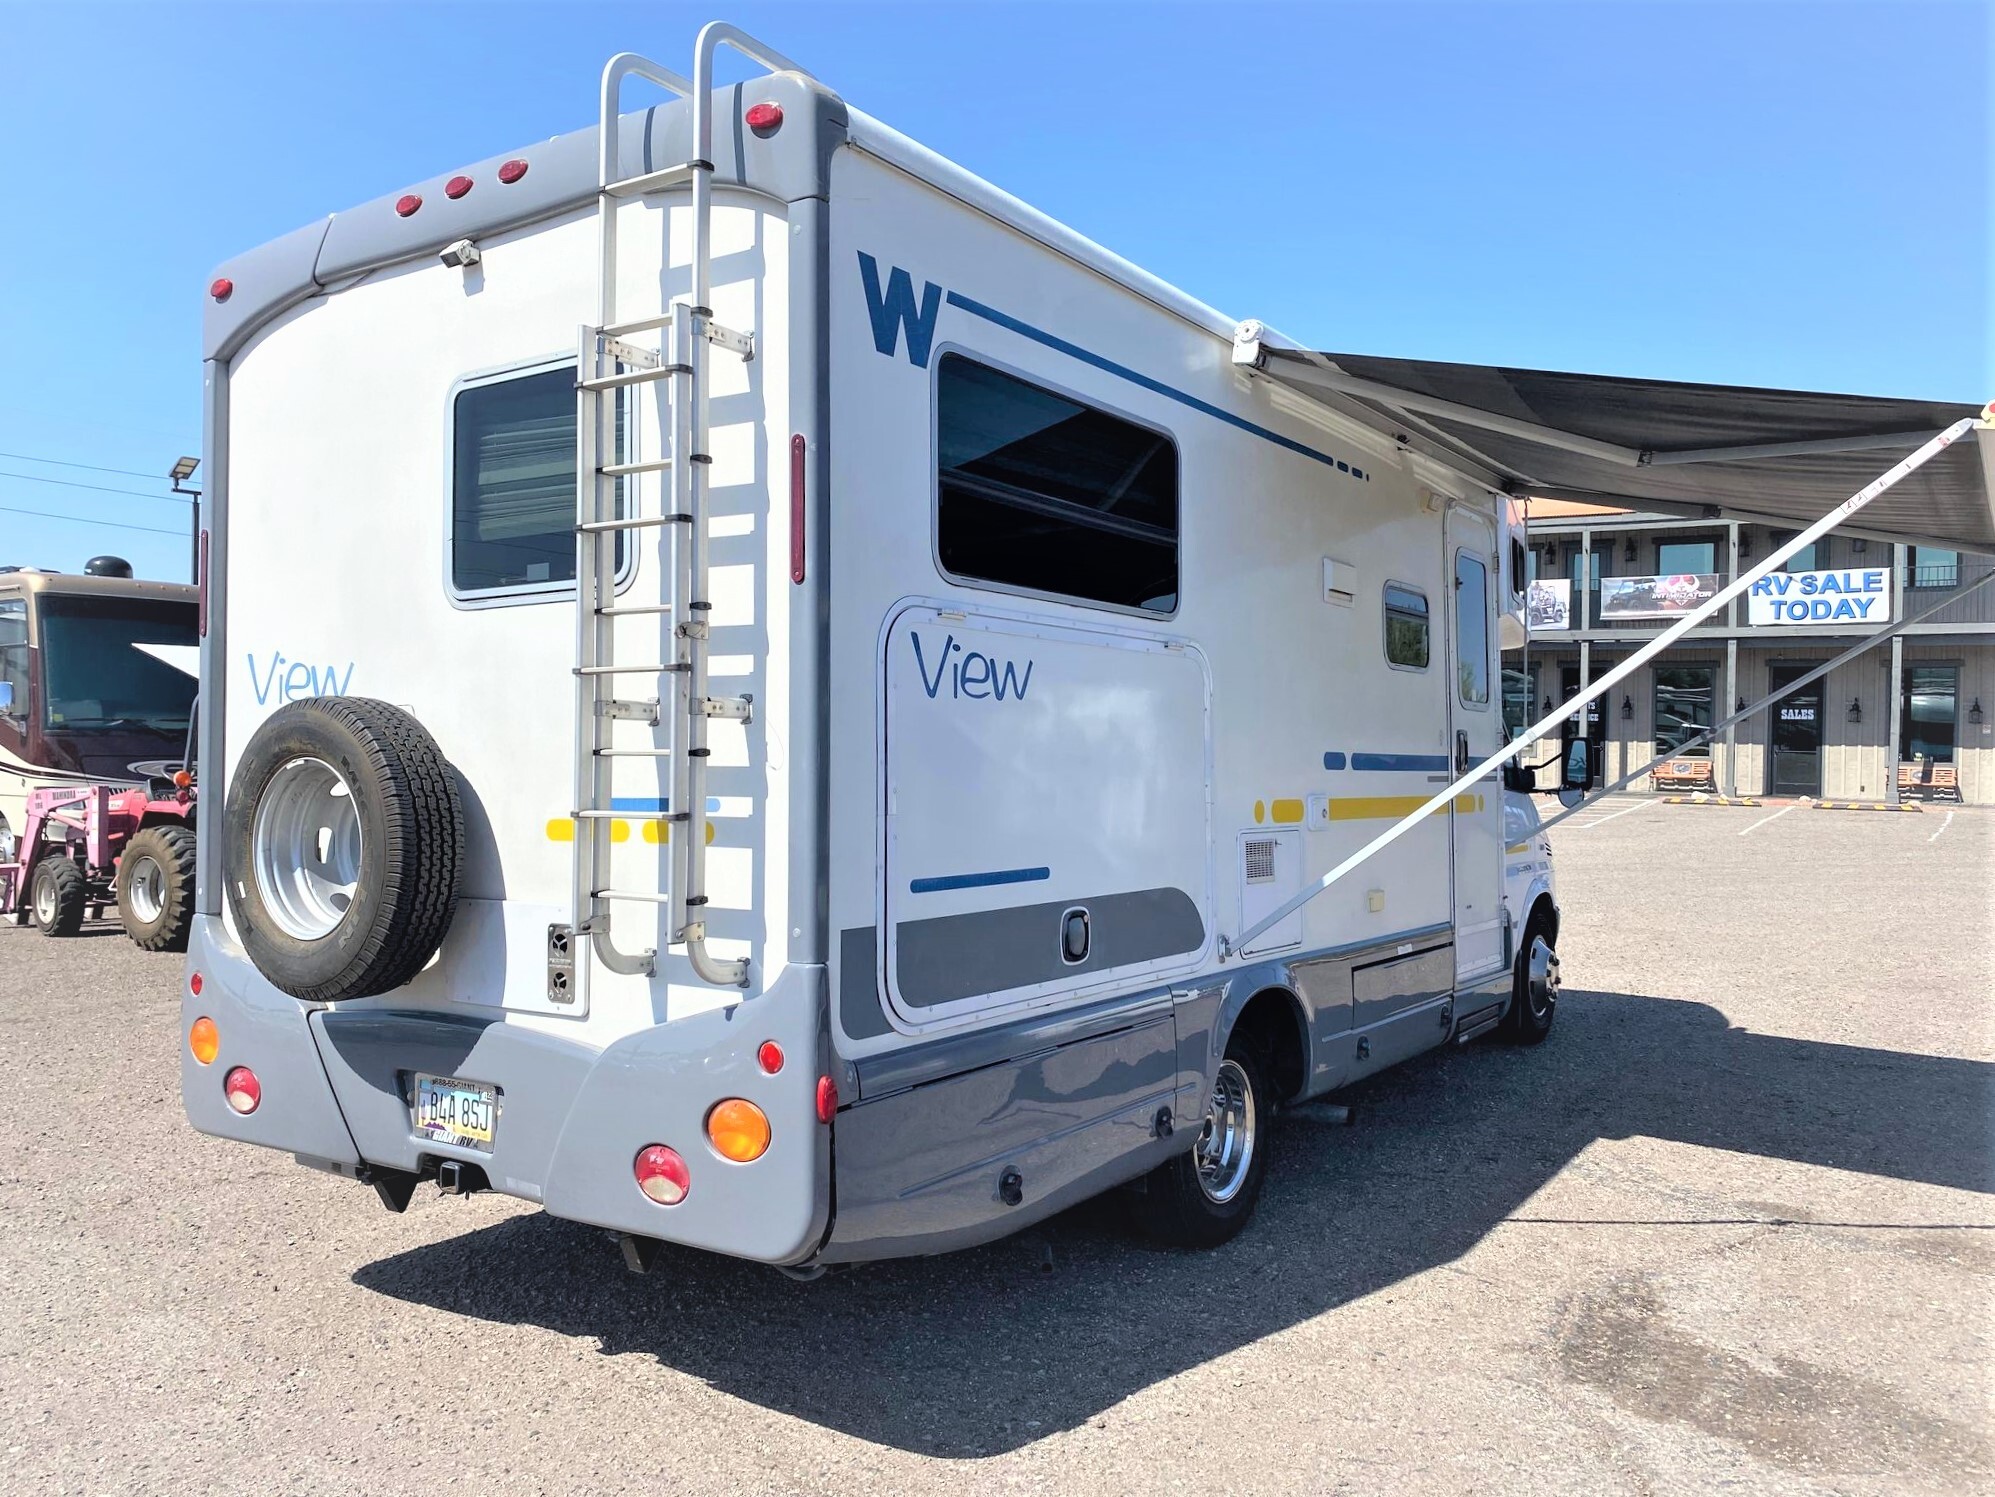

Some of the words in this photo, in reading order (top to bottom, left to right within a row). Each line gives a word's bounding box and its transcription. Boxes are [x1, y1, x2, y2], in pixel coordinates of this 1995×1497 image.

[857, 250, 942, 369] W
[1651, 591, 1712, 600] INTIMIDATOR
[1752, 575, 1793, 596] RV
[1799, 571, 1883, 595] SALE
[1770, 597, 1876, 620] TODAY
[247, 650, 354, 705] View
[911, 631, 1033, 701] View
[1781, 709, 1815, 720] SALES
[430, 1092, 456, 1125] B4A
[461, 1097, 489, 1131] 8SJ
